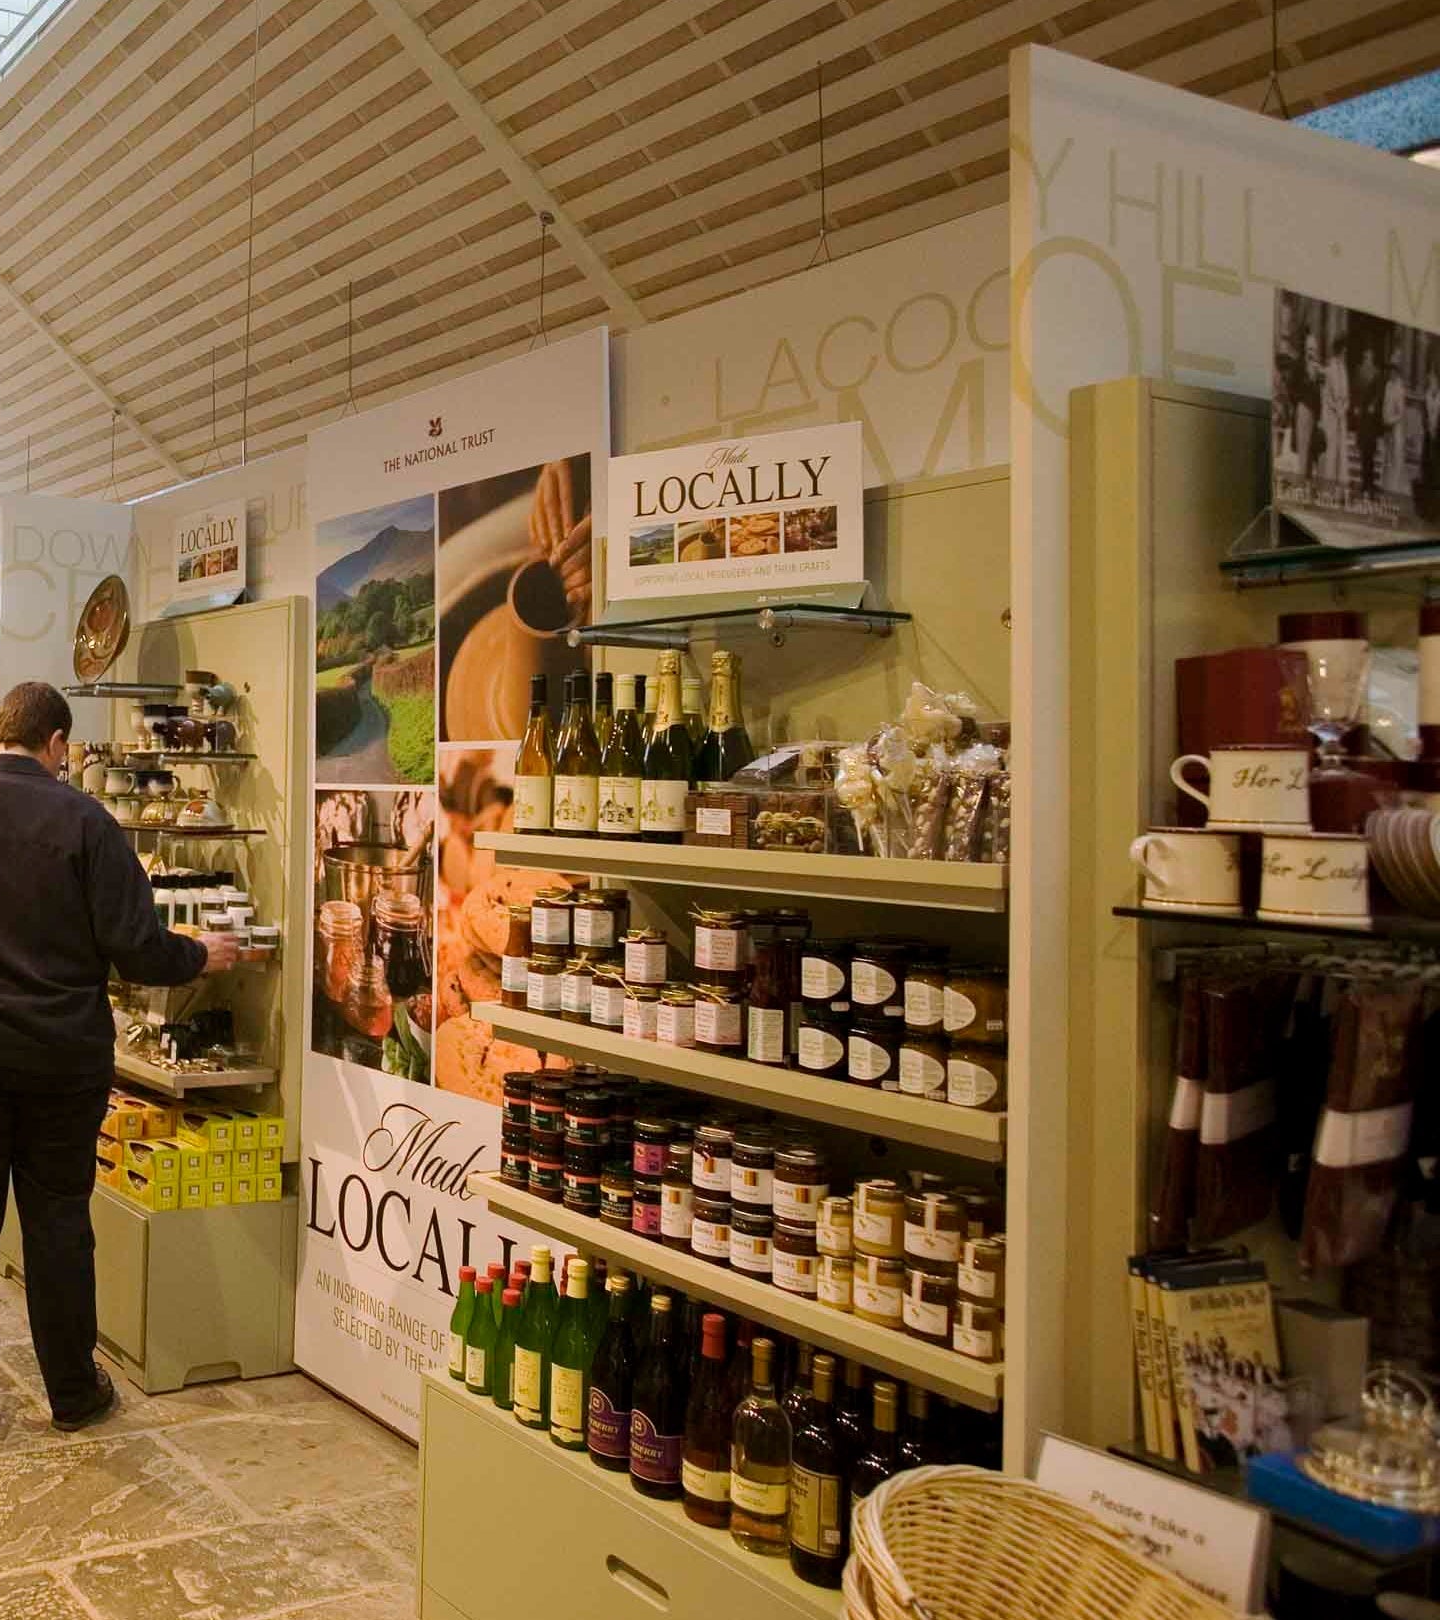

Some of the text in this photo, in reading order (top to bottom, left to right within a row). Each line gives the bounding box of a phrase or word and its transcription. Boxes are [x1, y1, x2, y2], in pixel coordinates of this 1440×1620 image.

[1107, 147, 1287, 287] HILL
[383, 428, 496, 474] THE NATIONAL TRUST
[633, 456, 832, 518] LOCALLY
[12, 524, 154, 572] DOWN
[180, 515, 238, 555] LOCALLY
[316, 1268, 446, 1355] AN INSPIRING RANGE OF
[332, 1306, 382, 1351] SELECTED
[385, 1335, 400, 1360] BY
[403, 1345, 425, 1374] THE
